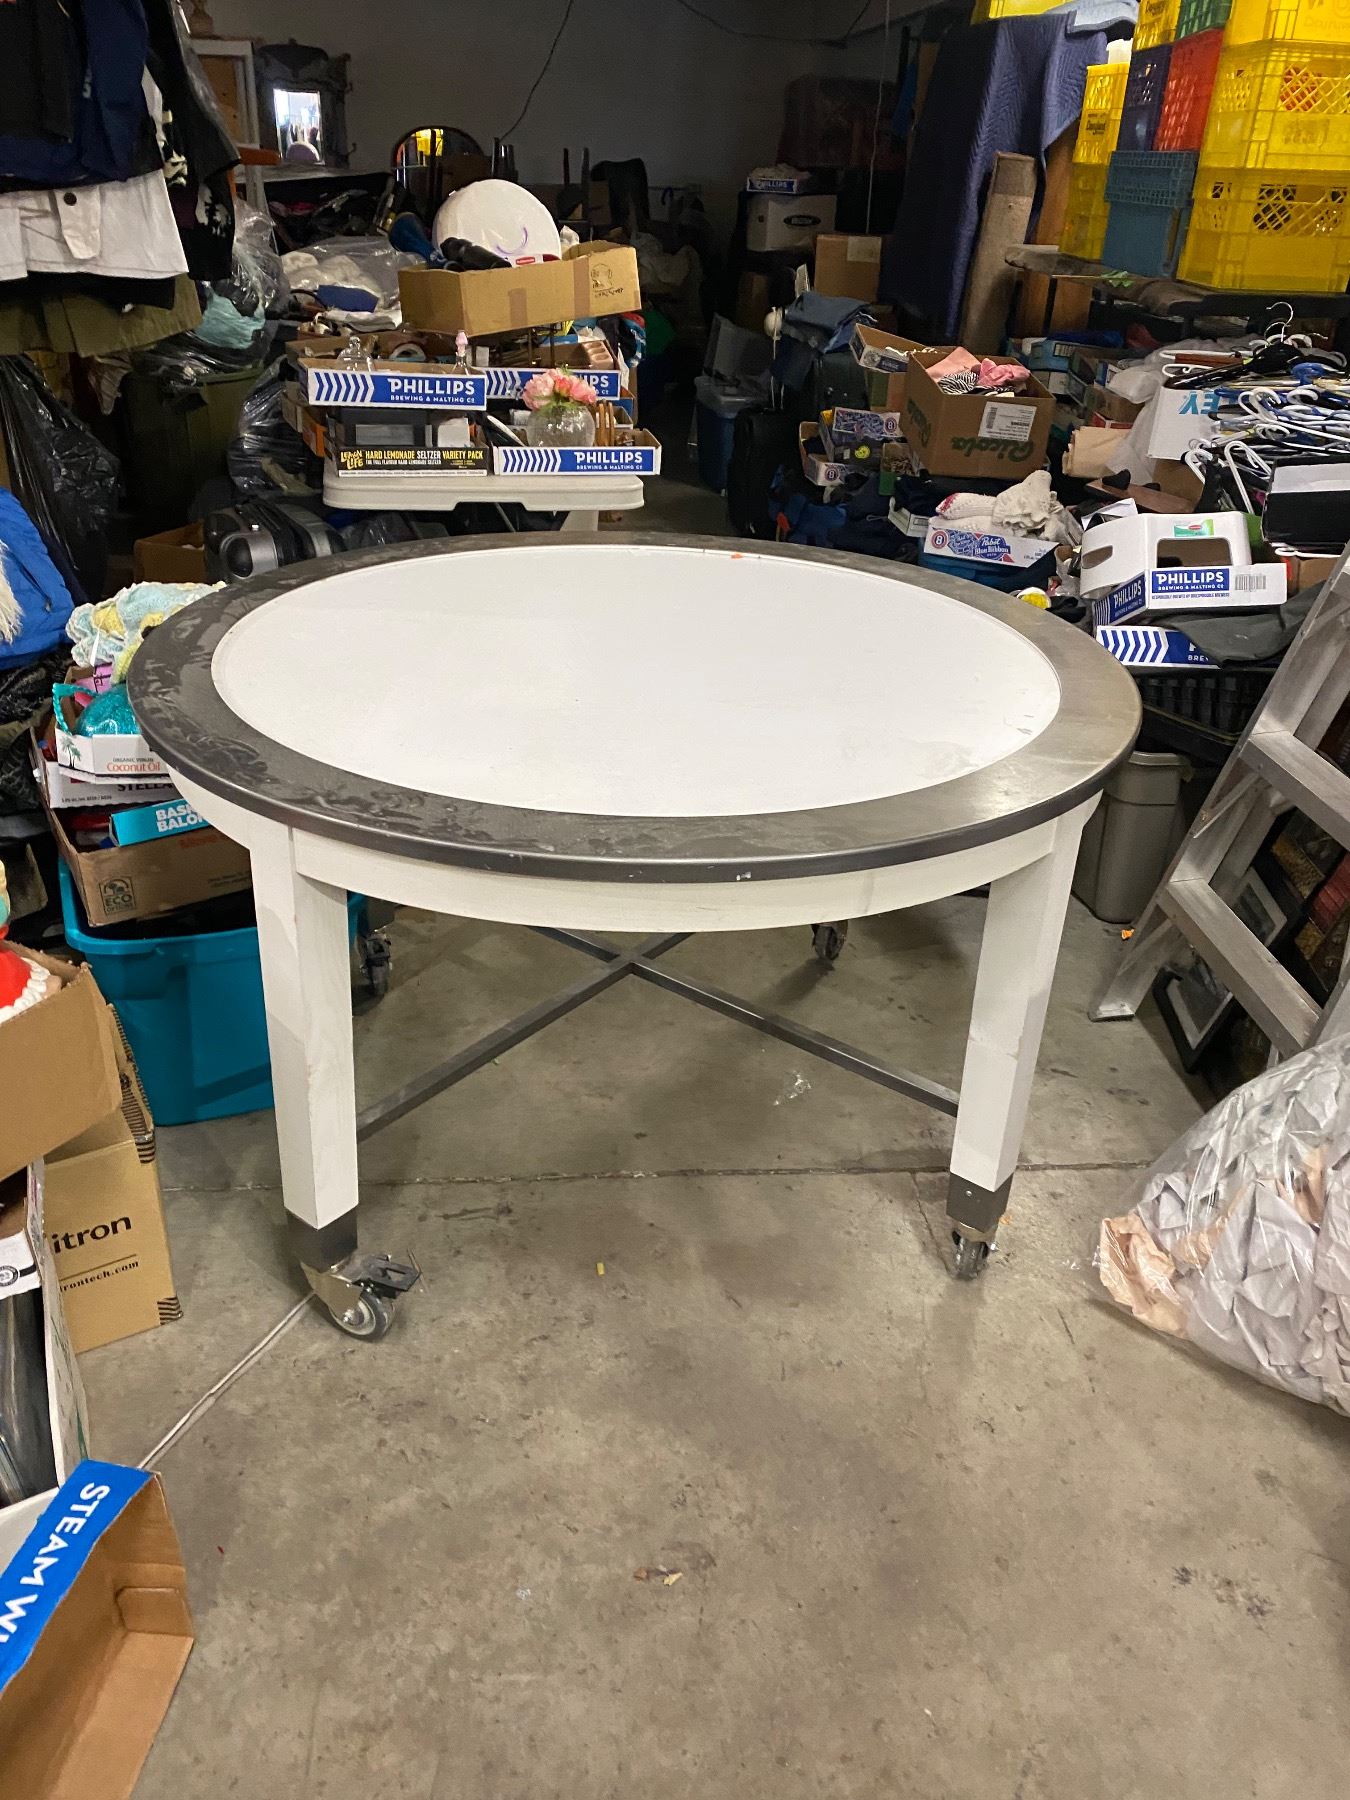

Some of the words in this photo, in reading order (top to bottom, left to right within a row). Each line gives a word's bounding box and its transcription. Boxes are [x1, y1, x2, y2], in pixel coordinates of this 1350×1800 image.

[387, 378, 475, 395] PHILLIPS
[340, 450, 362, 463] LEMON
[365, 450, 383, 460] HARD
[384, 450, 415, 460] LEMONADE
[417, 450, 442, 460] SELTZER
[443, 450, 466, 460] VARIETY
[468, 450, 484, 460] PACK
[574, 451, 643, 464] PHILLIPS
[346, 457, 363, 470] LIFE
[1156, 571, 1224, 585] PHILLIPS
[1113, 579, 1142, 609] PHILLIPS
[107, 762, 146, 772] Coconut
[148, 762, 160, 771] Oil
[105, 894, 132, 906] ECO
[20, 1482, 110, 1586] STEAM
